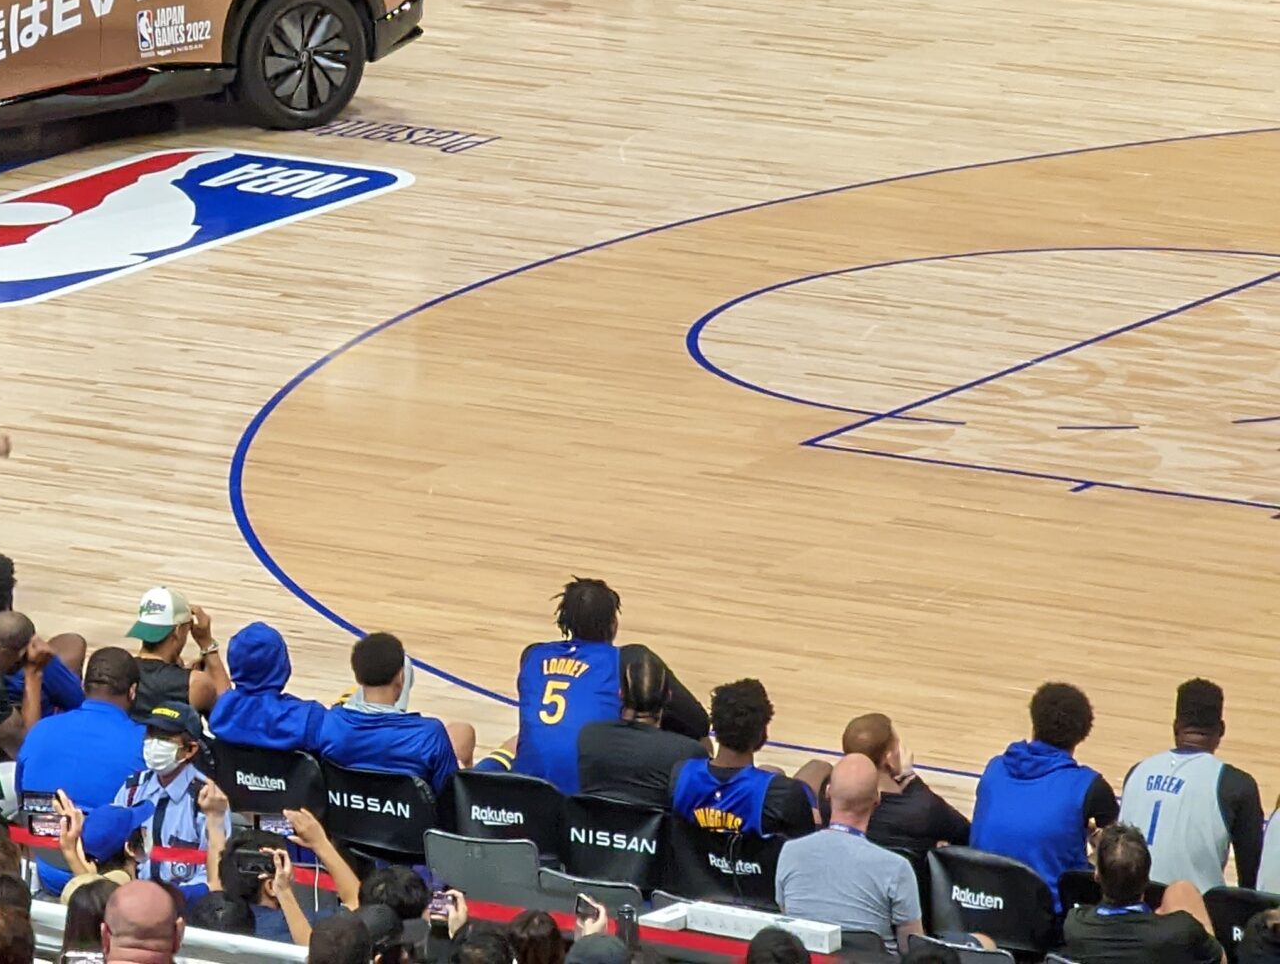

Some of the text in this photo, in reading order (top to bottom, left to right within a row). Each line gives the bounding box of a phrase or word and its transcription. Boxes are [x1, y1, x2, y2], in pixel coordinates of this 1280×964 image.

[154, 5, 185, 28] JAPAN
[155, 20, 212, 48] GAMES 2022
[199, 162, 370, 200] NBA
[543, 658, 590, 678] LOONEY
[539, 680, 570, 725] 5
[236, 770, 287, 792] Rakuten
[1146, 775, 1185, 794] GREEN
[328, 789, 410, 819] NISSAN
[471, 805, 524, 826] Rakuten
[1147, 800, 1162, 846] 1
[570, 827, 657, 855] NISSAN
[952, 885, 1004, 911] Rakuten
